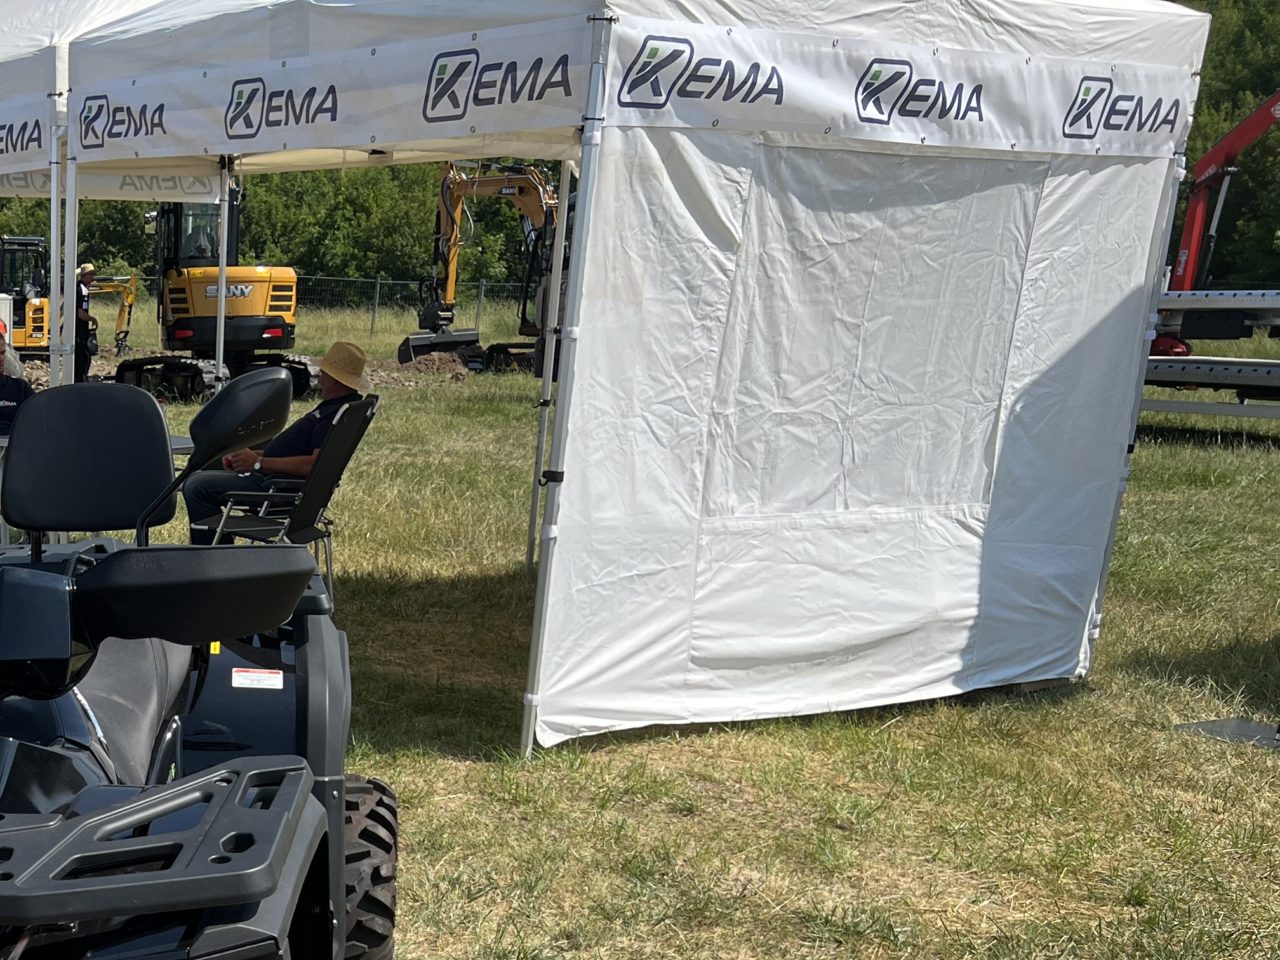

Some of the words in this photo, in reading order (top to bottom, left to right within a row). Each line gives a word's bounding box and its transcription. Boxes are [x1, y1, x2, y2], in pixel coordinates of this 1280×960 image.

[423, 49, 572, 122] KEMA
[618, 35, 783, 109] KEMA
[855, 58, 984, 125] KEMA
[80, 95, 167, 149] KEMA
[224, 77, 337, 139] KEMA
[1063, 76, 1180, 138] KEMA
